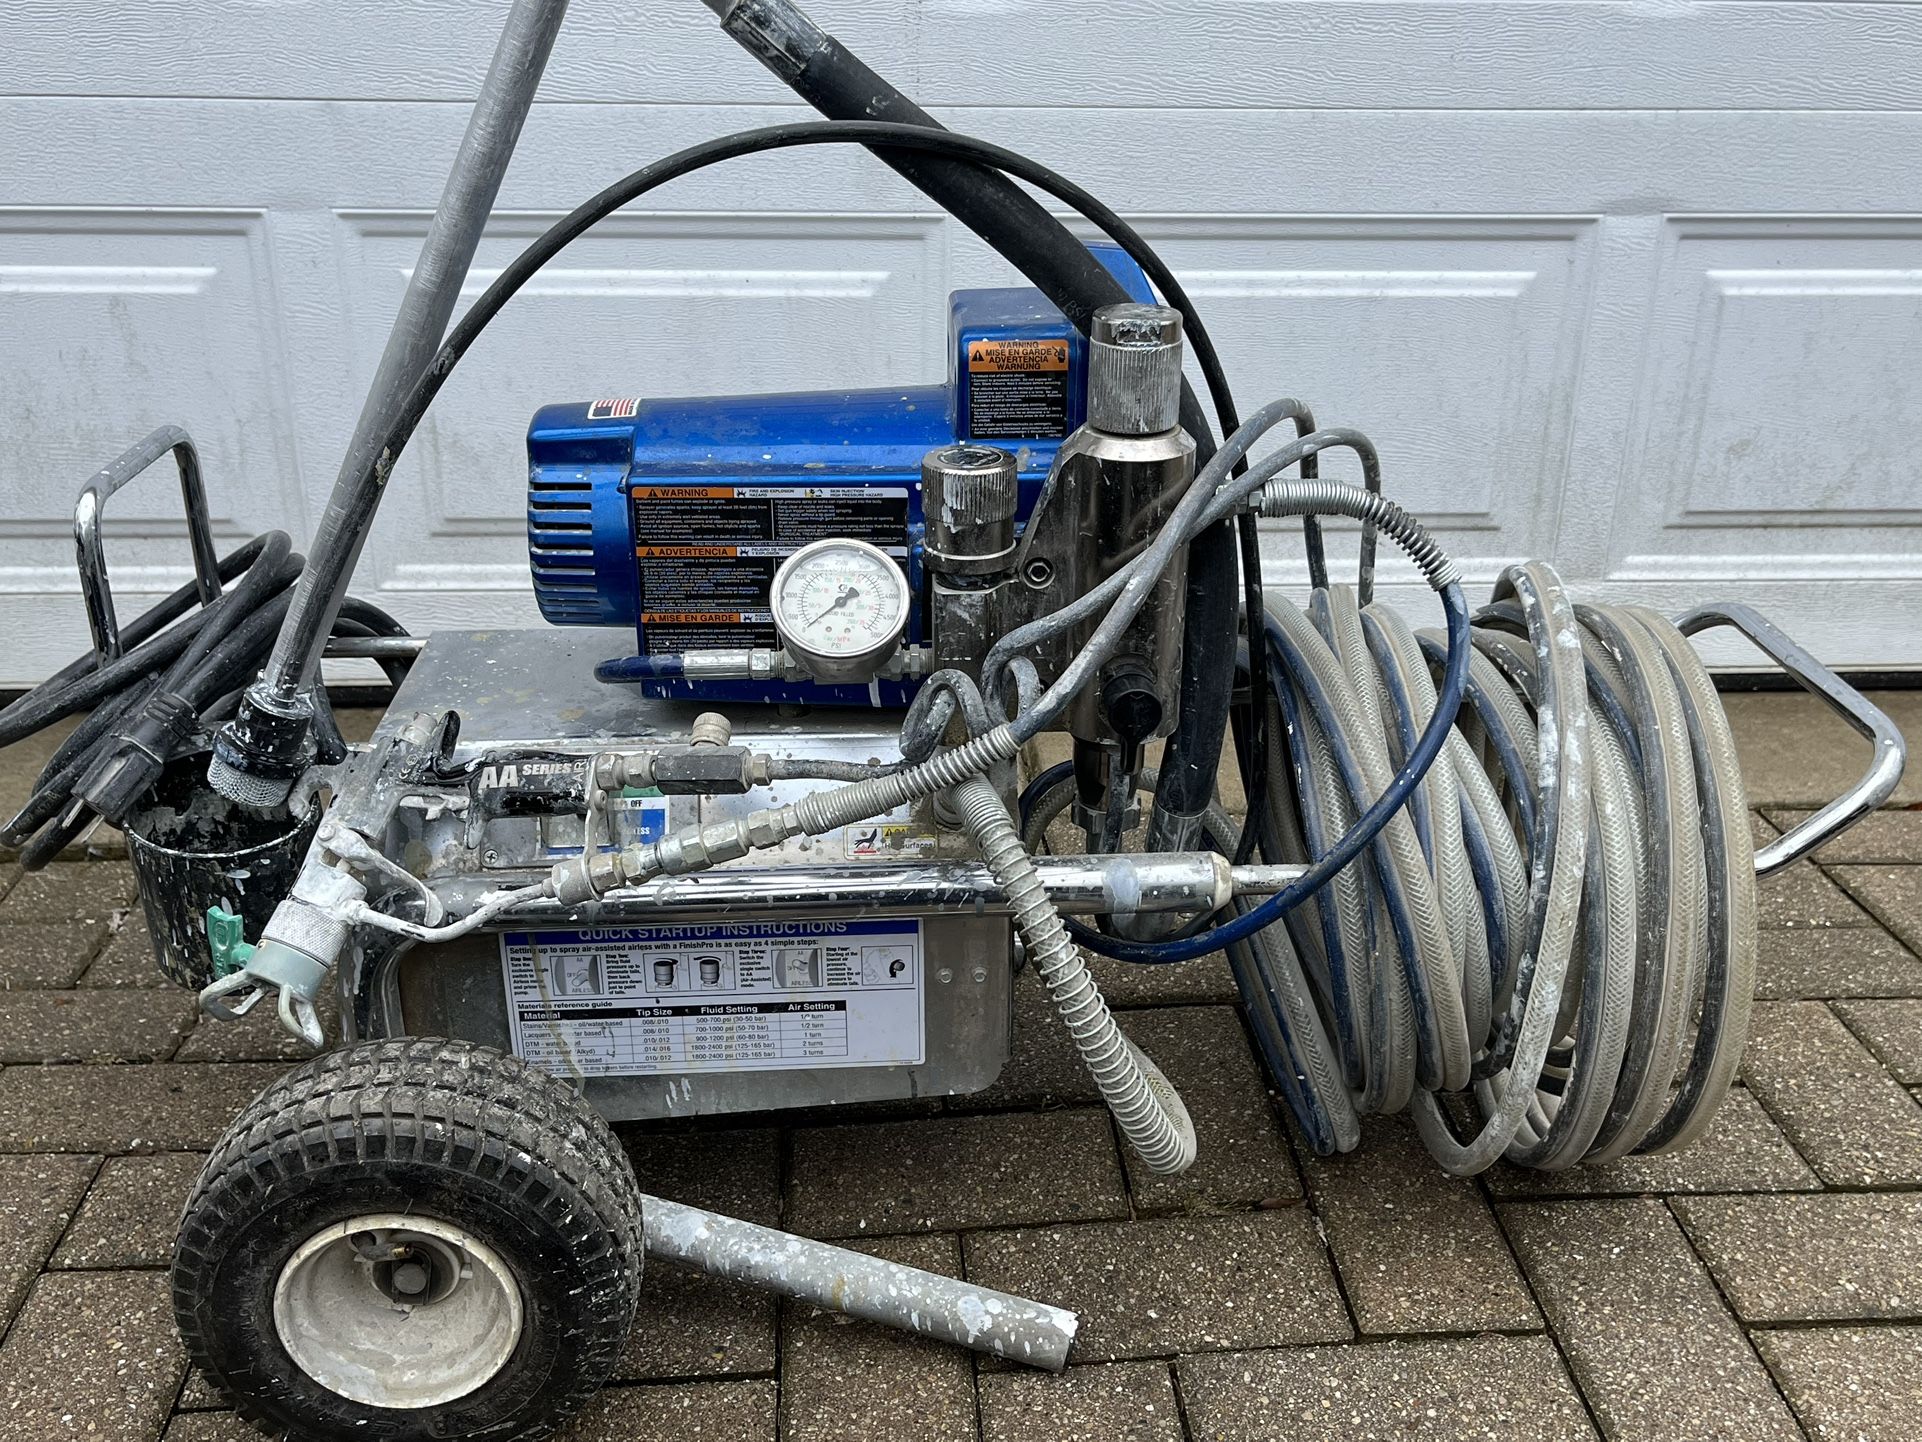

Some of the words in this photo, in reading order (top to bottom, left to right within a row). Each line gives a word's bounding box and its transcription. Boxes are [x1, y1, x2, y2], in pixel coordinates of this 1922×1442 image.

[478, 764, 519, 789] AA
[522, 762, 574, 775] SERIES
[578, 928, 634, 940] QUICK
[638, 925, 717, 939] STARTUP
[722, 921, 847, 936] INSTRUCTIONS
[582, 944, 625, 952] air-assisted
